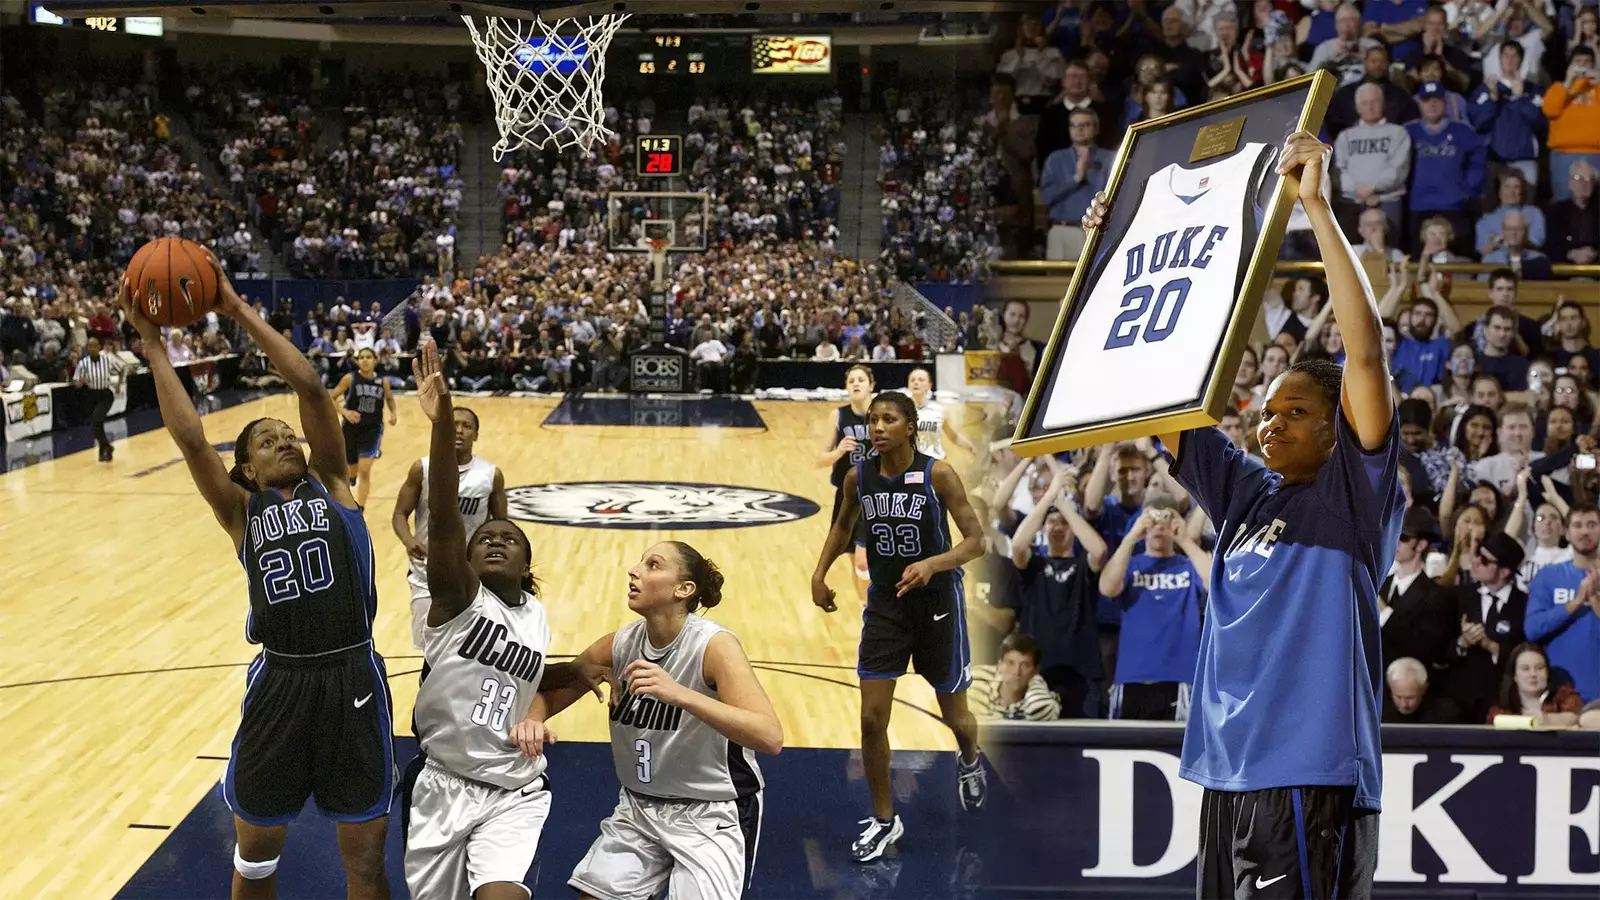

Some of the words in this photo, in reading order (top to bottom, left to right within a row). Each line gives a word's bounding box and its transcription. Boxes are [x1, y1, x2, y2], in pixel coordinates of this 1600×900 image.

[646, 153, 673, 172] 28
[1123, 225, 1229, 286] DUKE
[1103, 277, 1192, 350] 20
[635, 358, 679, 376] BOBS
[251, 498, 329, 552] DUKE
[862, 493, 926, 520] DUKE
[872, 523, 921, 557] 33
[259, 538, 334, 605] 20
[1132, 570, 1190, 590] DUKE
[458, 616, 541, 683] UConn
[470, 677, 518, 731] 33
[635, 739, 652, 783] 3
[1081, 748, 1600, 885] DKE
